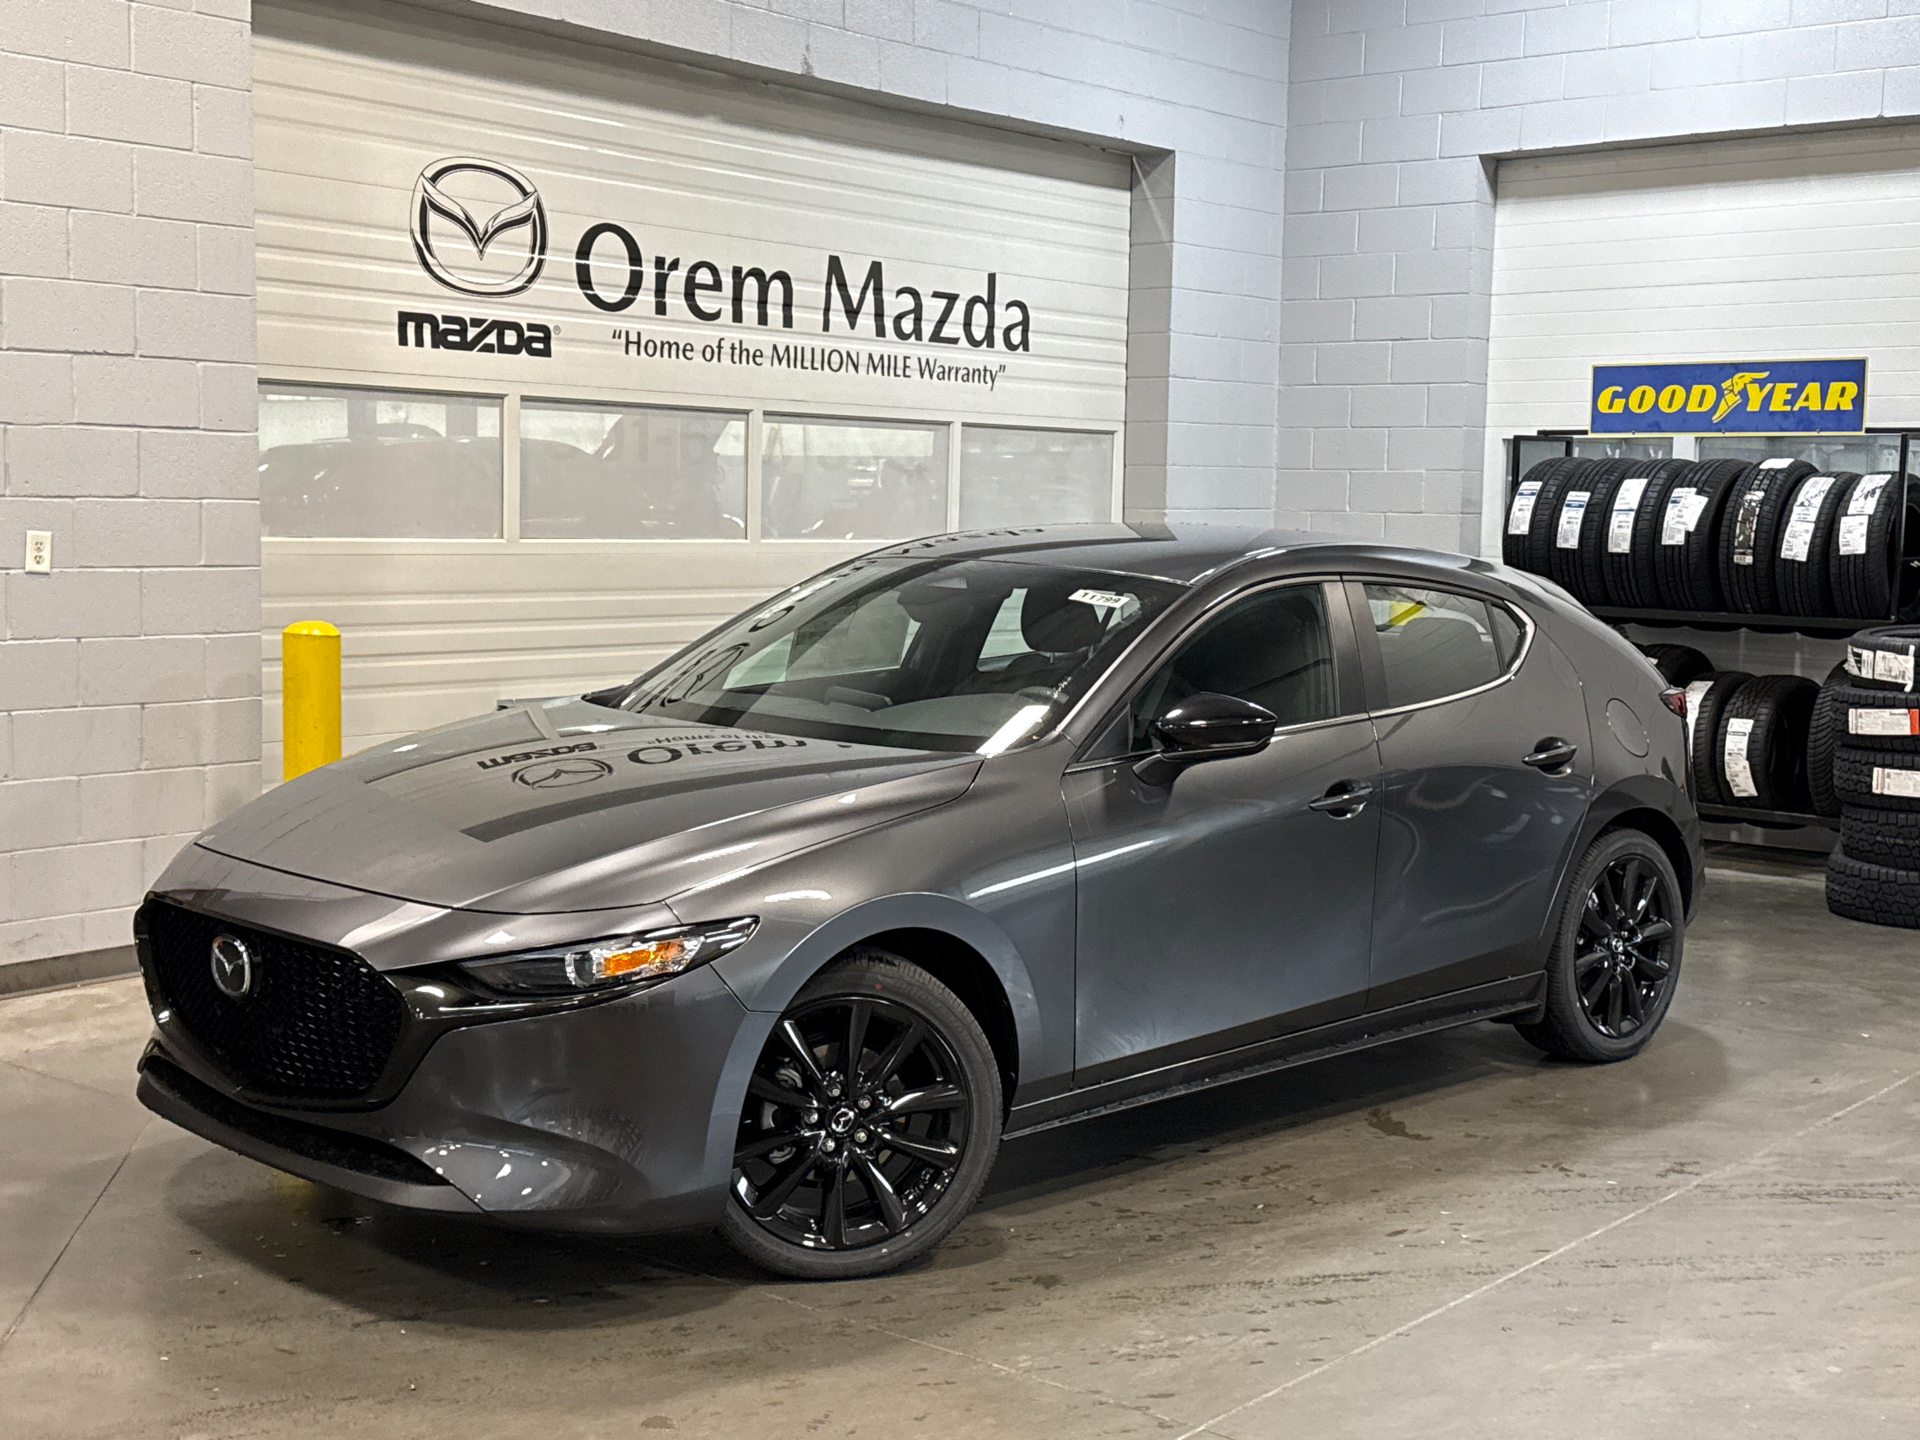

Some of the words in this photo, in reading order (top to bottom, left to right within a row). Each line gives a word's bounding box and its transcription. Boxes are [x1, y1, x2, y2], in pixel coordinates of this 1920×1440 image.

[575, 222, 793, 328] Orem
[822, 254, 1030, 352] Mazda
[397, 310, 552, 358] mazda
[702, 337, 725, 363] of
[730, 339, 763, 366] the
[771, 344, 860, 374] MILLION
[866, 352, 911, 378] MILE
